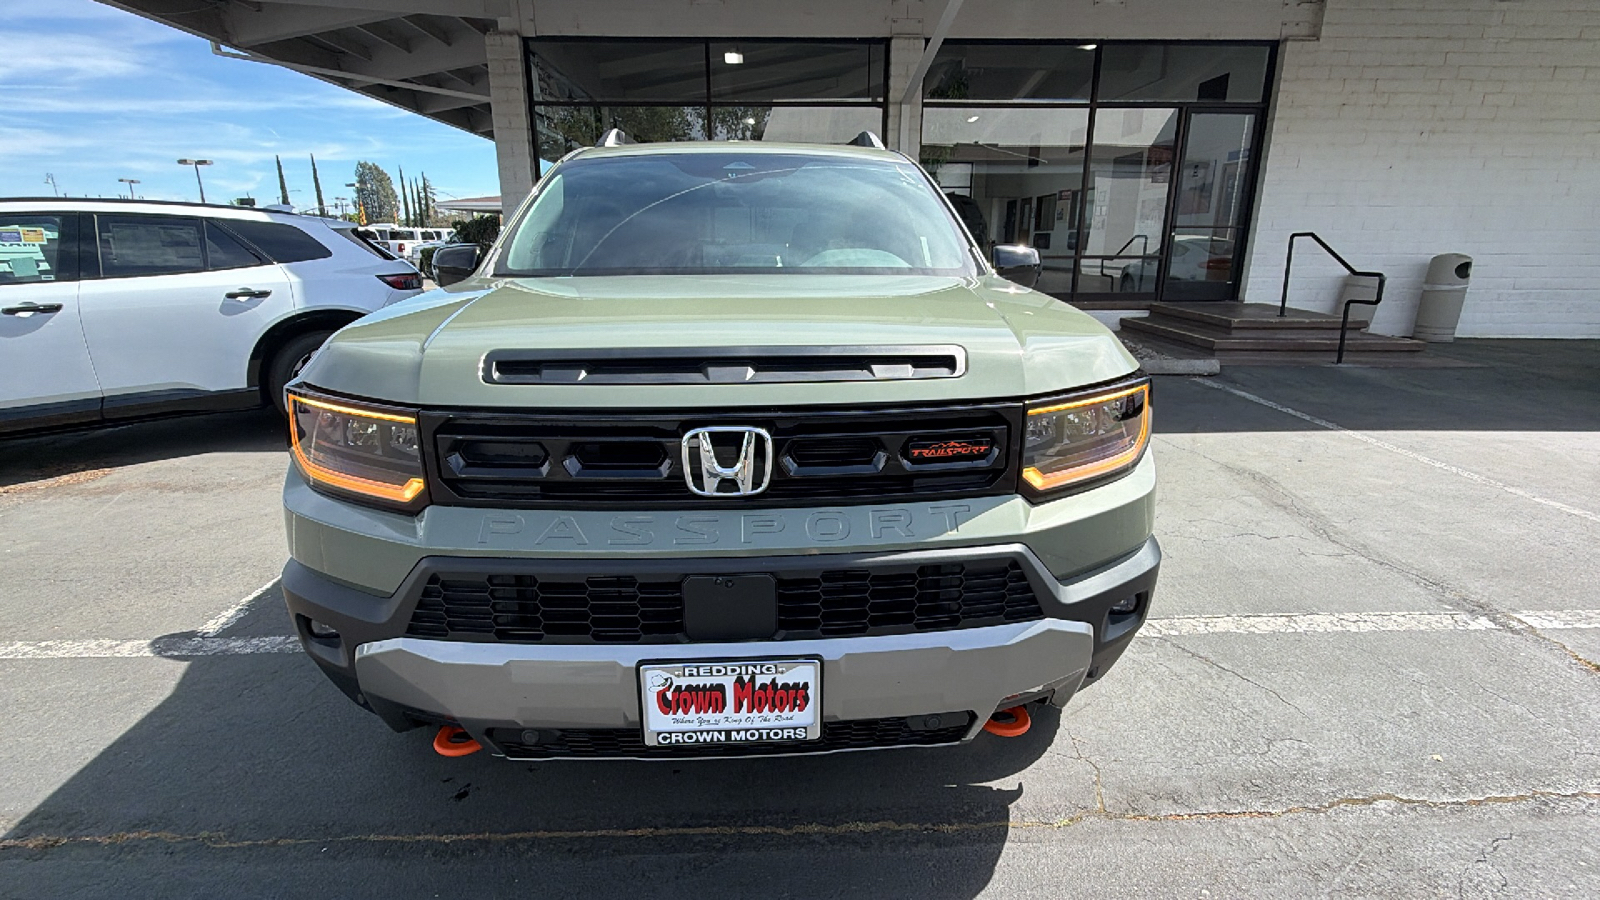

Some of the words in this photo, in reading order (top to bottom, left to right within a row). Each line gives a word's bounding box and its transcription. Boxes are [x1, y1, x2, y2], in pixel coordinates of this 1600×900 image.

[911, 446, 989, 457] TRAILSPORT
[477, 504, 971, 546] PASSPORT
[684, 665, 777, 676] REDDING
[656, 680, 726, 716] Crown
[733, 678, 809, 714] Motors
[671, 716, 695, 725] Where
[723, 715, 743, 725] King
[744, 715, 755, 725] Of
[757, 714, 771, 723] The
[773, 713, 795, 722] Road
[657, 731, 725, 744] CROWN
[731, 728, 807, 741] MOTORS
